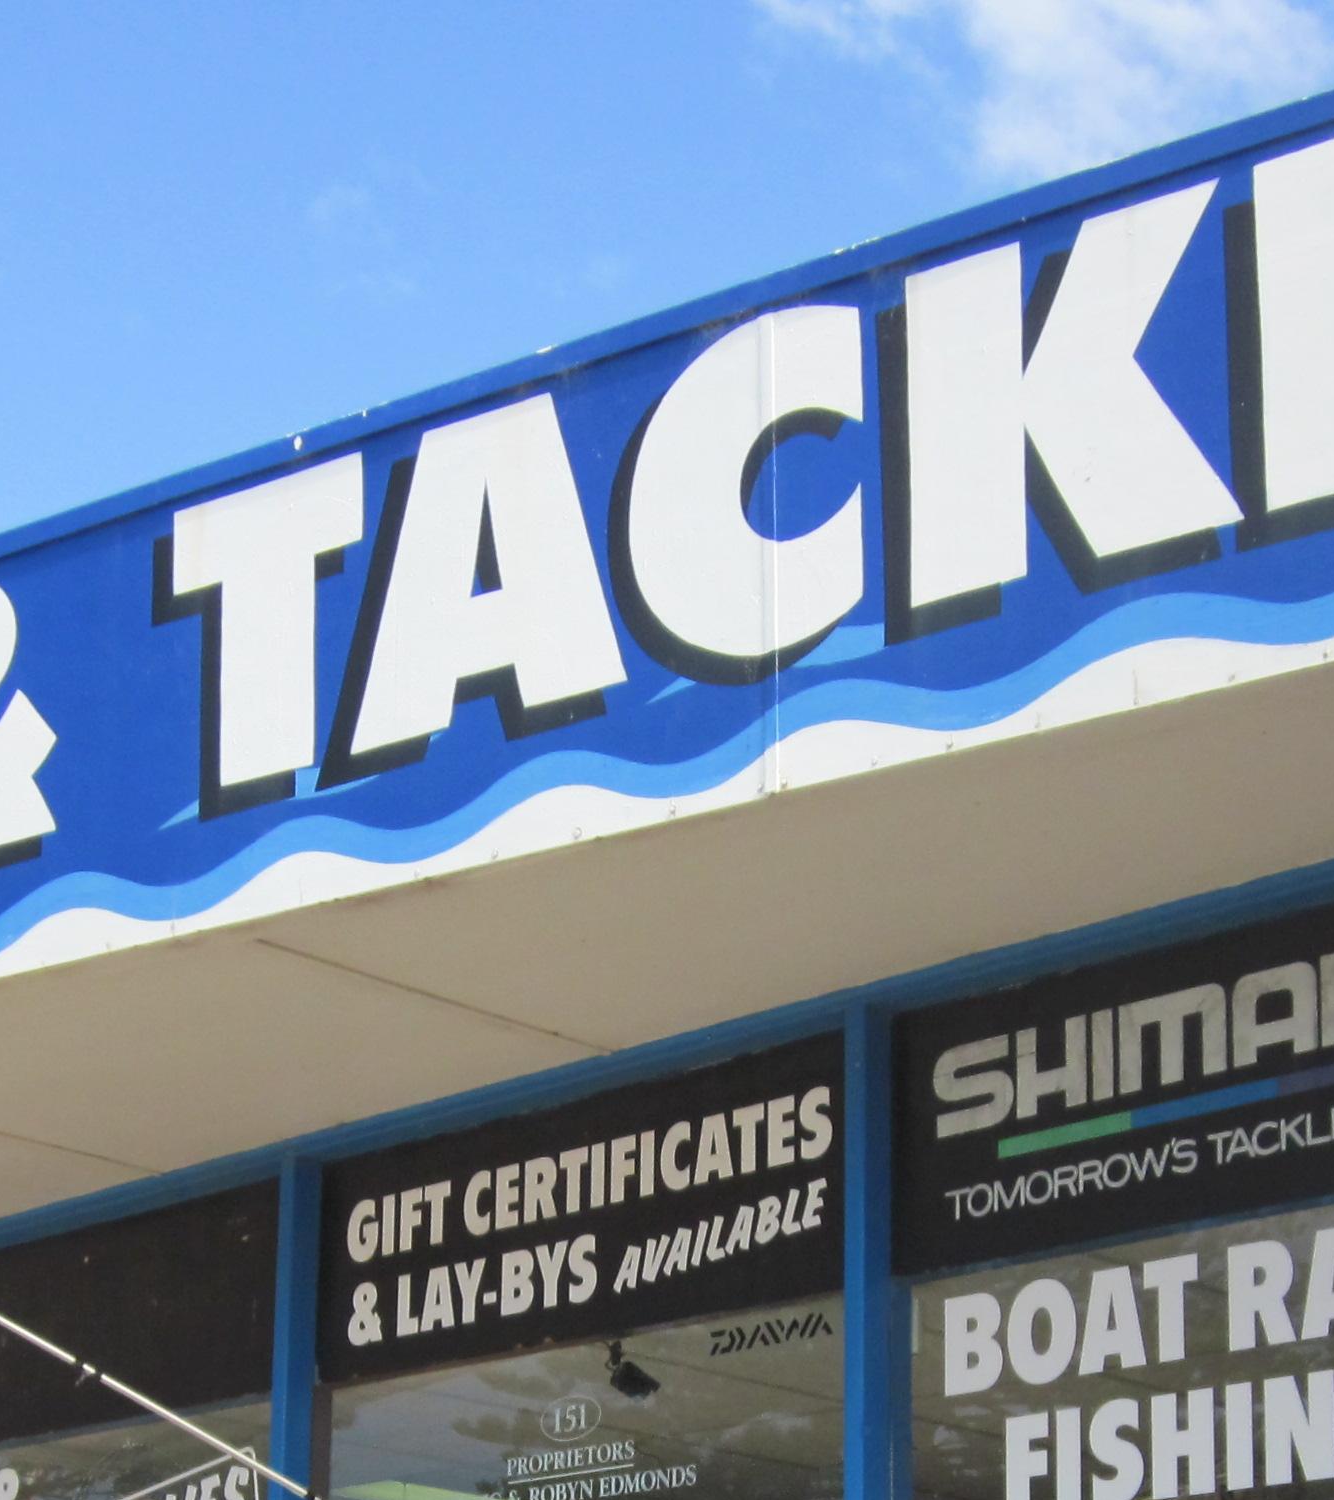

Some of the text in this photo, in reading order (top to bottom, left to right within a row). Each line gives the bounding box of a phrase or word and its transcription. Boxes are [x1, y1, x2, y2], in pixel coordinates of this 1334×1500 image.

[347, 1086, 834, 1263] GIFT CERTIFICATES
[945, 1138, 1197, 1220] TOMORROW'S
[347, 1178, 828, 1347] & LAY-BYS AVAILABLE
[943, 1253, 1199, 1396] BOAT
[507, 1440, 635, 1476] PROPRIETORS
[552, 1404, 586, 1433] 151
[599, 1464, 697, 1497] EDMONDS
